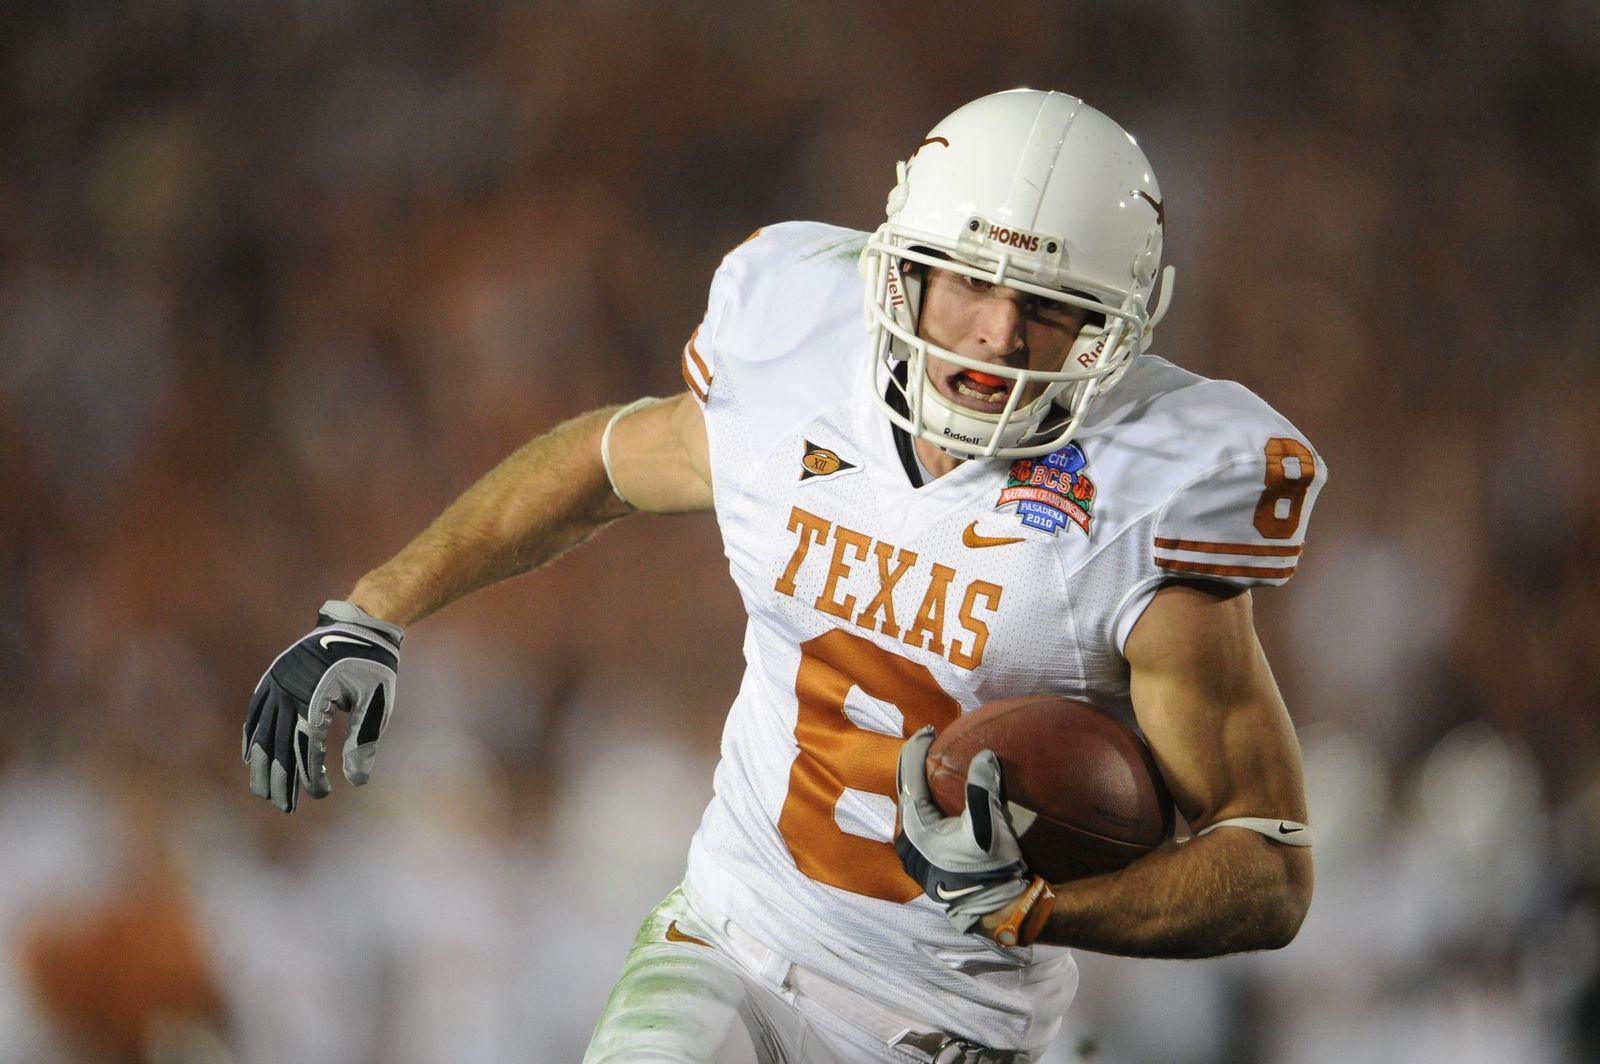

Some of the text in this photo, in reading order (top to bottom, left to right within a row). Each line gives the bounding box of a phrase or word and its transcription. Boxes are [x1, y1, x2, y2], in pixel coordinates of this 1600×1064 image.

[987, 224, 1040, 252] HORNS
[1077, 337, 1108, 369] Rid
[943, 427, 980, 445] Riddell
[811, 457, 828, 472] XII
[1048, 453, 1069, 467] citi
[1030, 465, 1073, 494] BCS
[1253, 437, 1315, 540] 8
[1004, 487, 1088, 525] NATIONAL CHAMPIONSHIP
[1020, 502, 1064, 523] PASADENA
[1026, 513, 1053, 529] 2010
[773, 505, 1004, 671] TEXAS
[778, 627, 962, 905] 8
